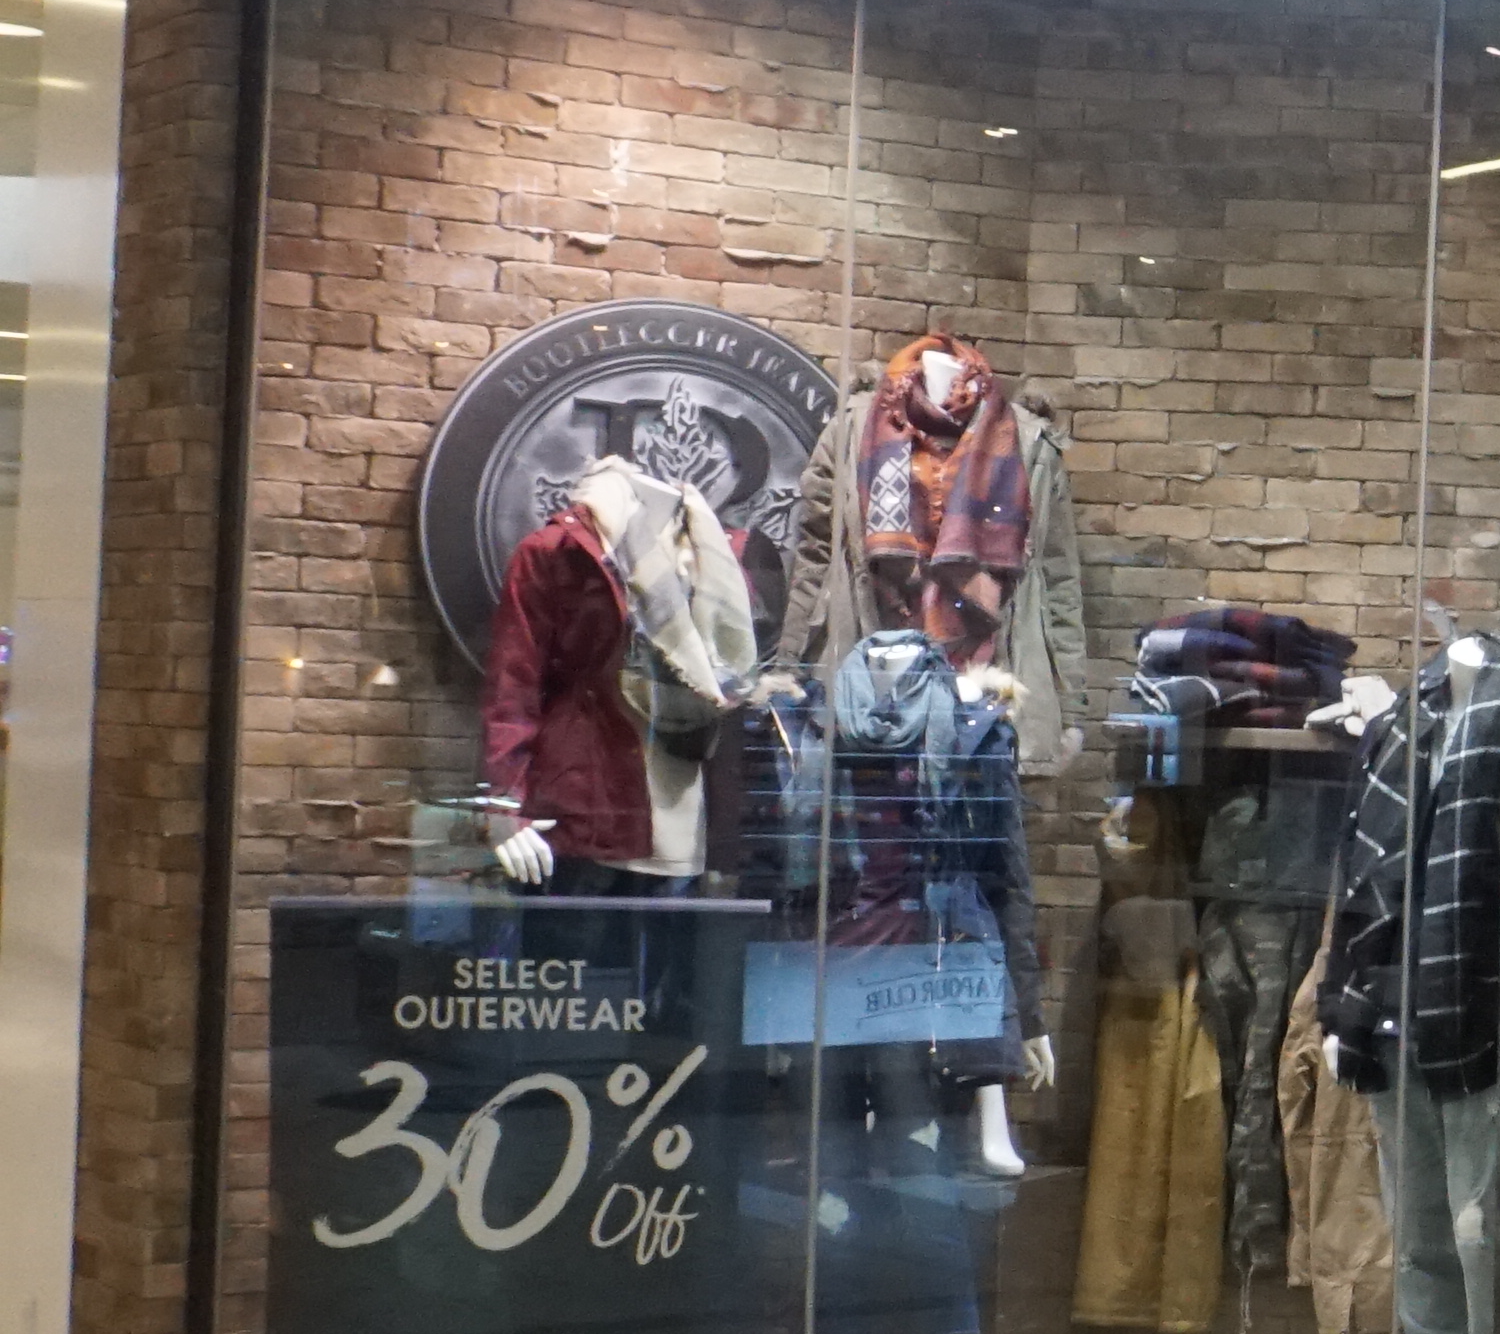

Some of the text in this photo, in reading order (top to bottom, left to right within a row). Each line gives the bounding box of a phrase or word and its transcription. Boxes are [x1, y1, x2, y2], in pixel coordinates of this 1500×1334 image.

[453, 958, 588, 991] SELECT
[394, 995, 647, 1033] OUTERWEAR
[313, 1044, 708, 1252] 30%
